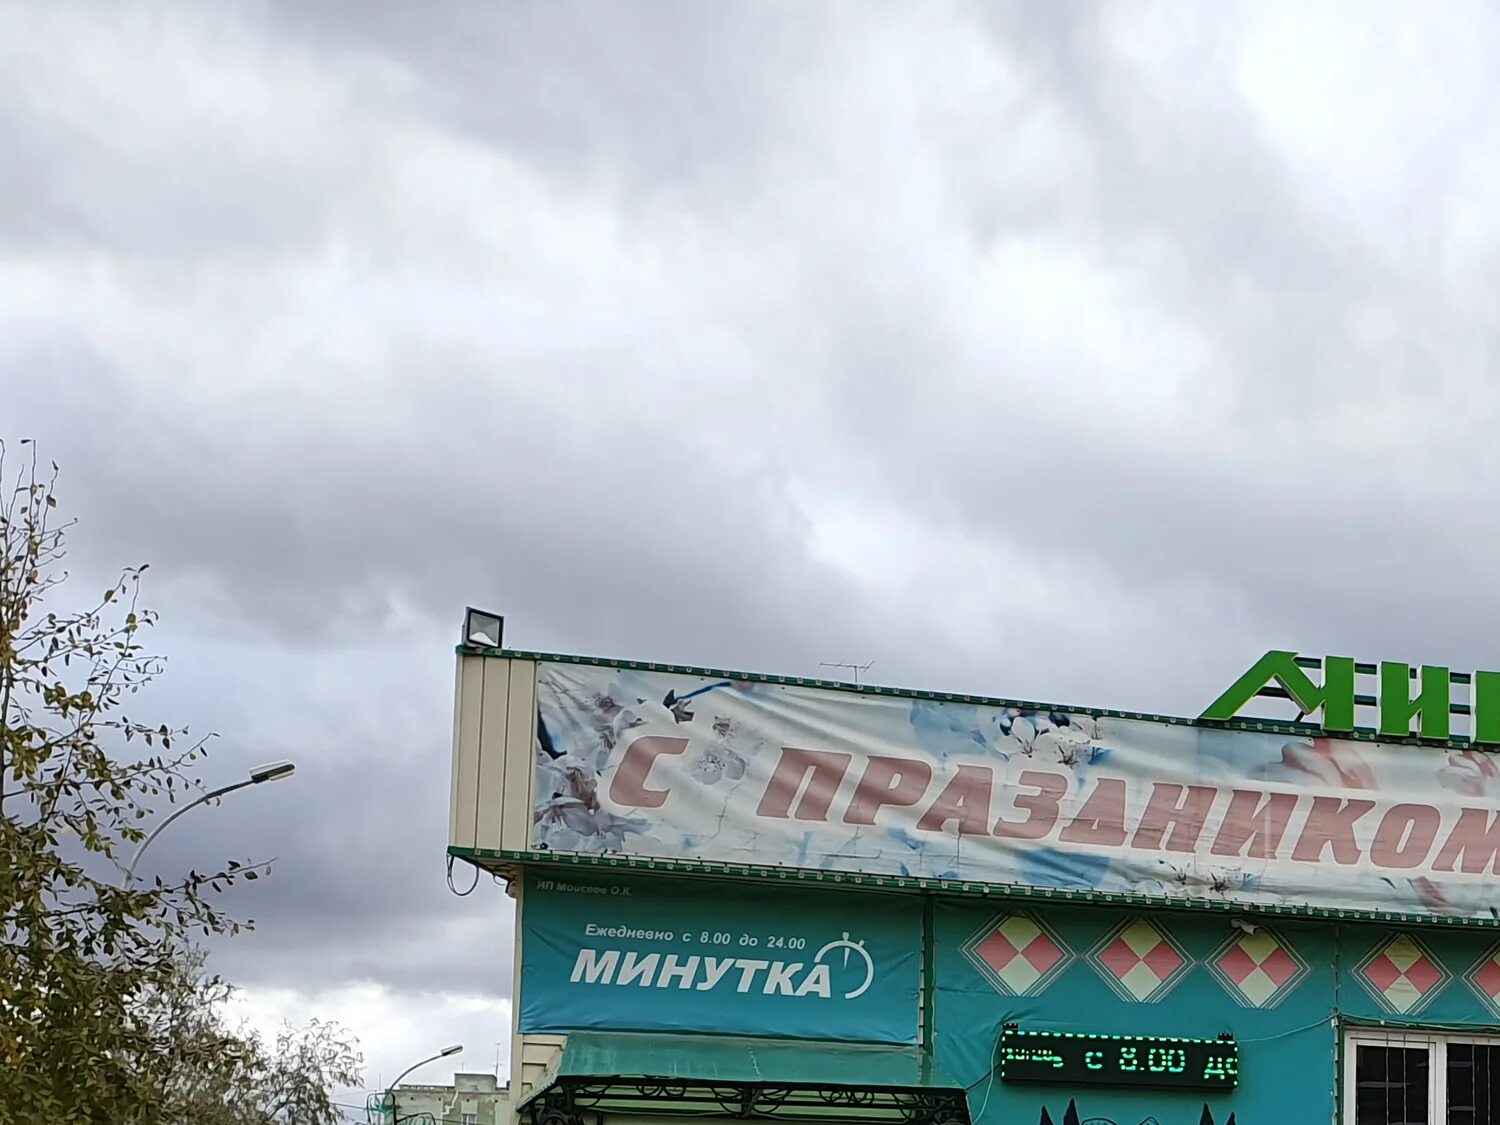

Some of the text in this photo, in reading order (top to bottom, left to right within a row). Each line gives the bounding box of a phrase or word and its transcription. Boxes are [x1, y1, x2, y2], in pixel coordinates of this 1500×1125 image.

[609, 735, 690, 809] С
[585, 923, 806, 950] Ежедневно с 8.00 до 24.00
[570, 948, 831, 998] МИНУТКА
[1119, 1047, 1185, 1073] 8.00
